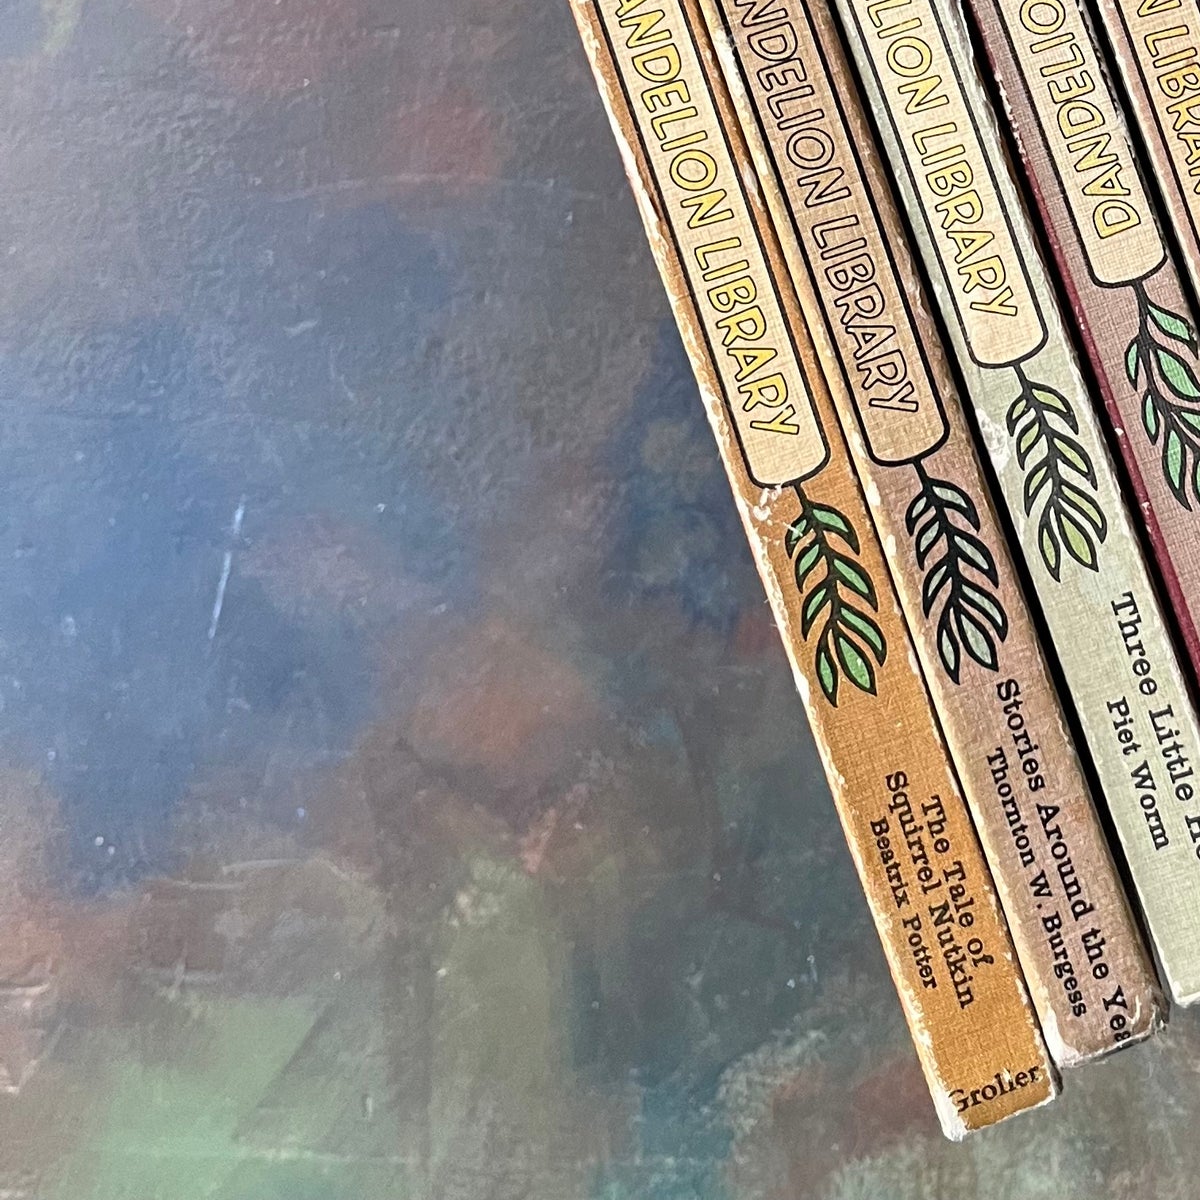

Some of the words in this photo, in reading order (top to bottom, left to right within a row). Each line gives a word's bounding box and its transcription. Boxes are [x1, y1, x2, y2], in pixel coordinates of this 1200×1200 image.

[910, 121, 1018, 321] LIBRARY
[692, 235, 801, 440] LIBRARY
[809, 213, 920, 417] LIBRARY
[1106, 696, 1141, 756] Piet
[1129, 759, 1171, 851] Worm
[1110, 591, 1160, 697] Three
[1148, 704, 1196, 802] Little
[884, 770, 942, 895] Squirrel
[927, 899, 977, 1010] Nutkin
[920, 794, 952, 854] The
[941, 860, 977, 928] Tale
[966, 937, 995, 968] of
[985, 746, 1037, 868] Thornton
[994, 678, 1048, 793] Stories
[1035, 801, 1095, 924] Around
[1080, 927, 1111, 981] the
[1101, 985, 1138, 1047] Yea
[1028, 870, 1053, 910] W.
[869, 817, 911, 908] Beatrix
[901, 913, 938, 990] Potter
[1039, 911, 1088, 1019] Burgess
